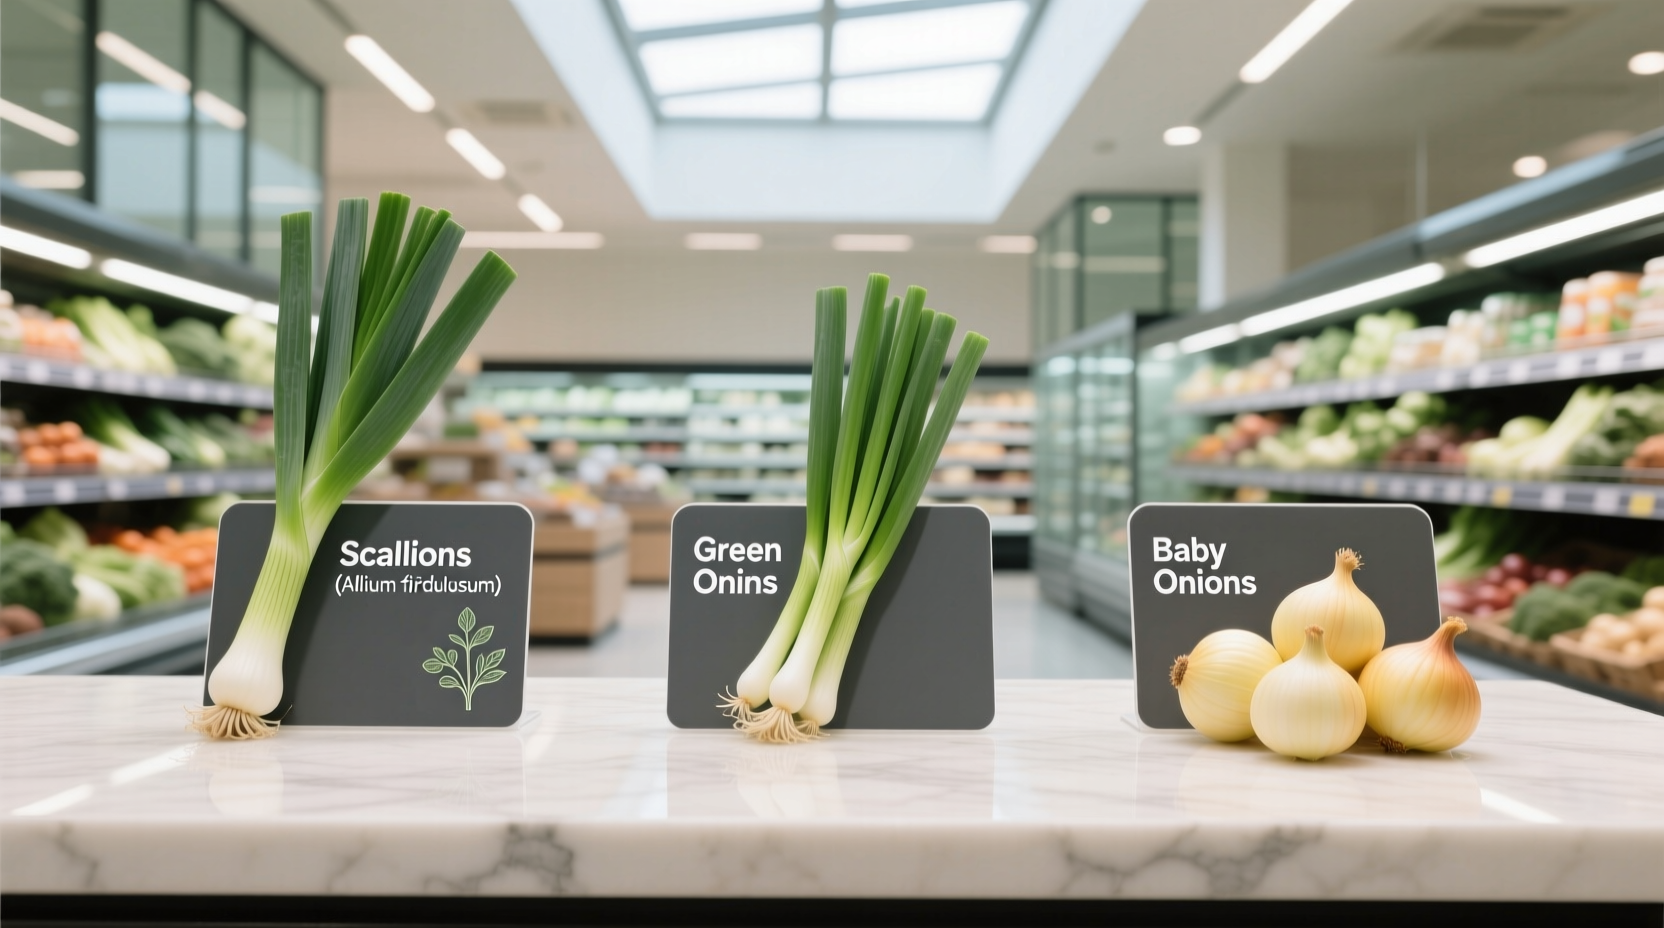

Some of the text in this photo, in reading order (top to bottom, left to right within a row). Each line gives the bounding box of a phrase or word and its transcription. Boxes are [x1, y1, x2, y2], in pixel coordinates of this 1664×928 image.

[339, 540, 472, 567] Scallions
[693, 535, 782, 563] Green
[1152, 536, 1227, 569] Baby
[335, 574, 396, 597] (Allium
[693, 567, 778, 595] Onins
[1153, 568, 1257, 595] Onions
